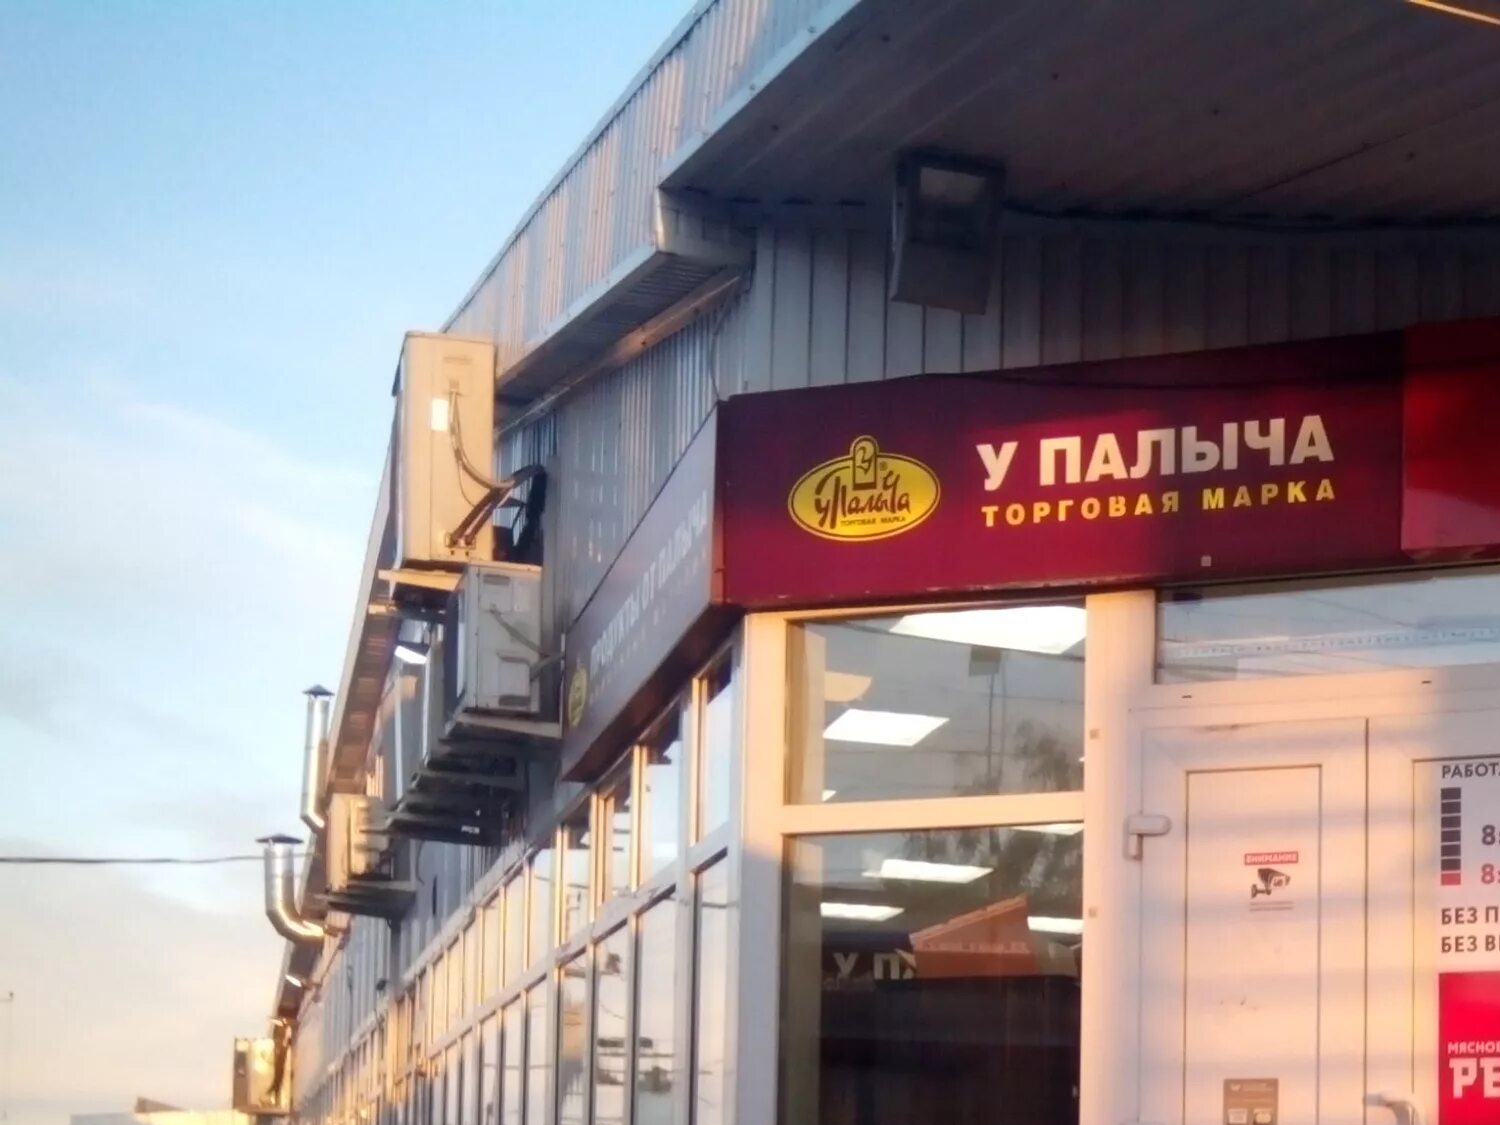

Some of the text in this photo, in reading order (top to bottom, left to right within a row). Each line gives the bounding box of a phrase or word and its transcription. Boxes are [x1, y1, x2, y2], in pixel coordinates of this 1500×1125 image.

[976, 413, 1334, 491] У ПАЛЫЧА
[980, 477, 1336, 528] ТОРГОВАЯ МАРКА
[1441, 907, 1478, 926] БЕЗ
[1441, 934, 1478, 954] БЕЗ
